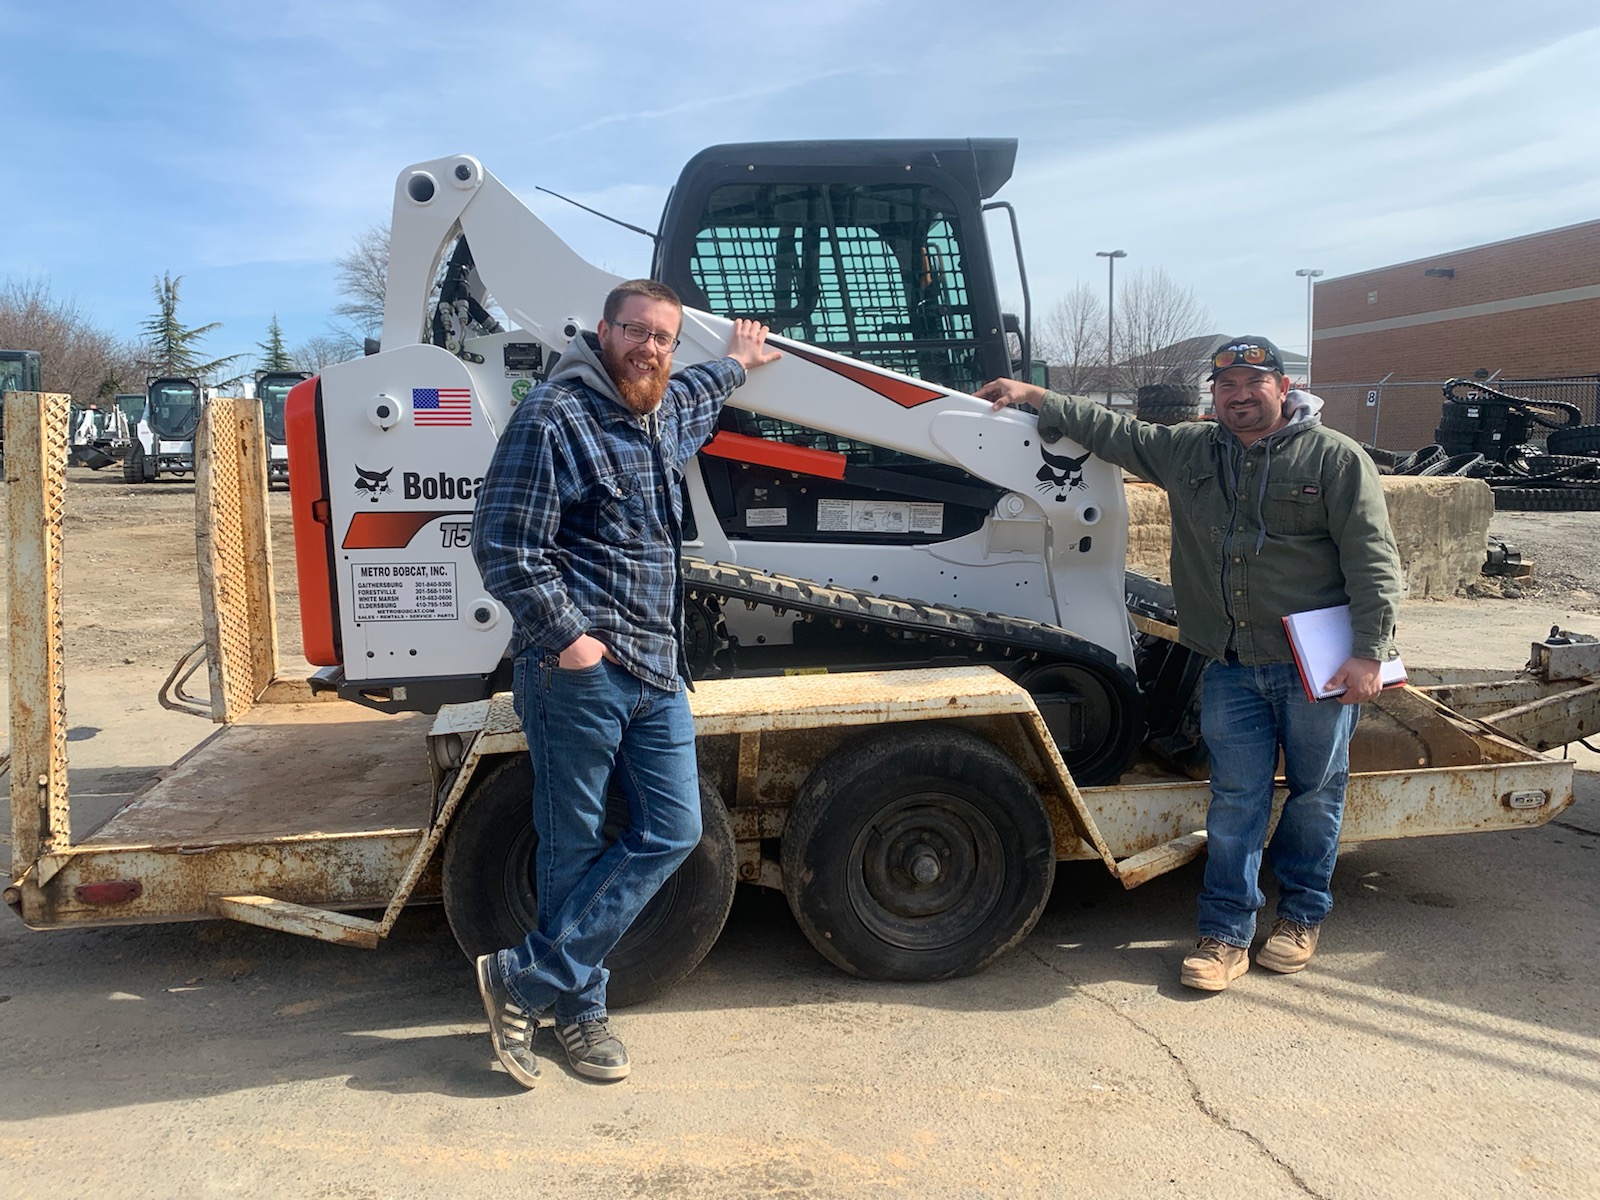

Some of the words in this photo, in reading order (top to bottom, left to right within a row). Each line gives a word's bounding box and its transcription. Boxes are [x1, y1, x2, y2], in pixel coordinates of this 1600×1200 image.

[1368, 392, 1375, 402] 8
[360, 567, 390, 577] METRO
[393, 566, 428, 578] BOBCAT,
[430, 566, 448, 576] INC.
